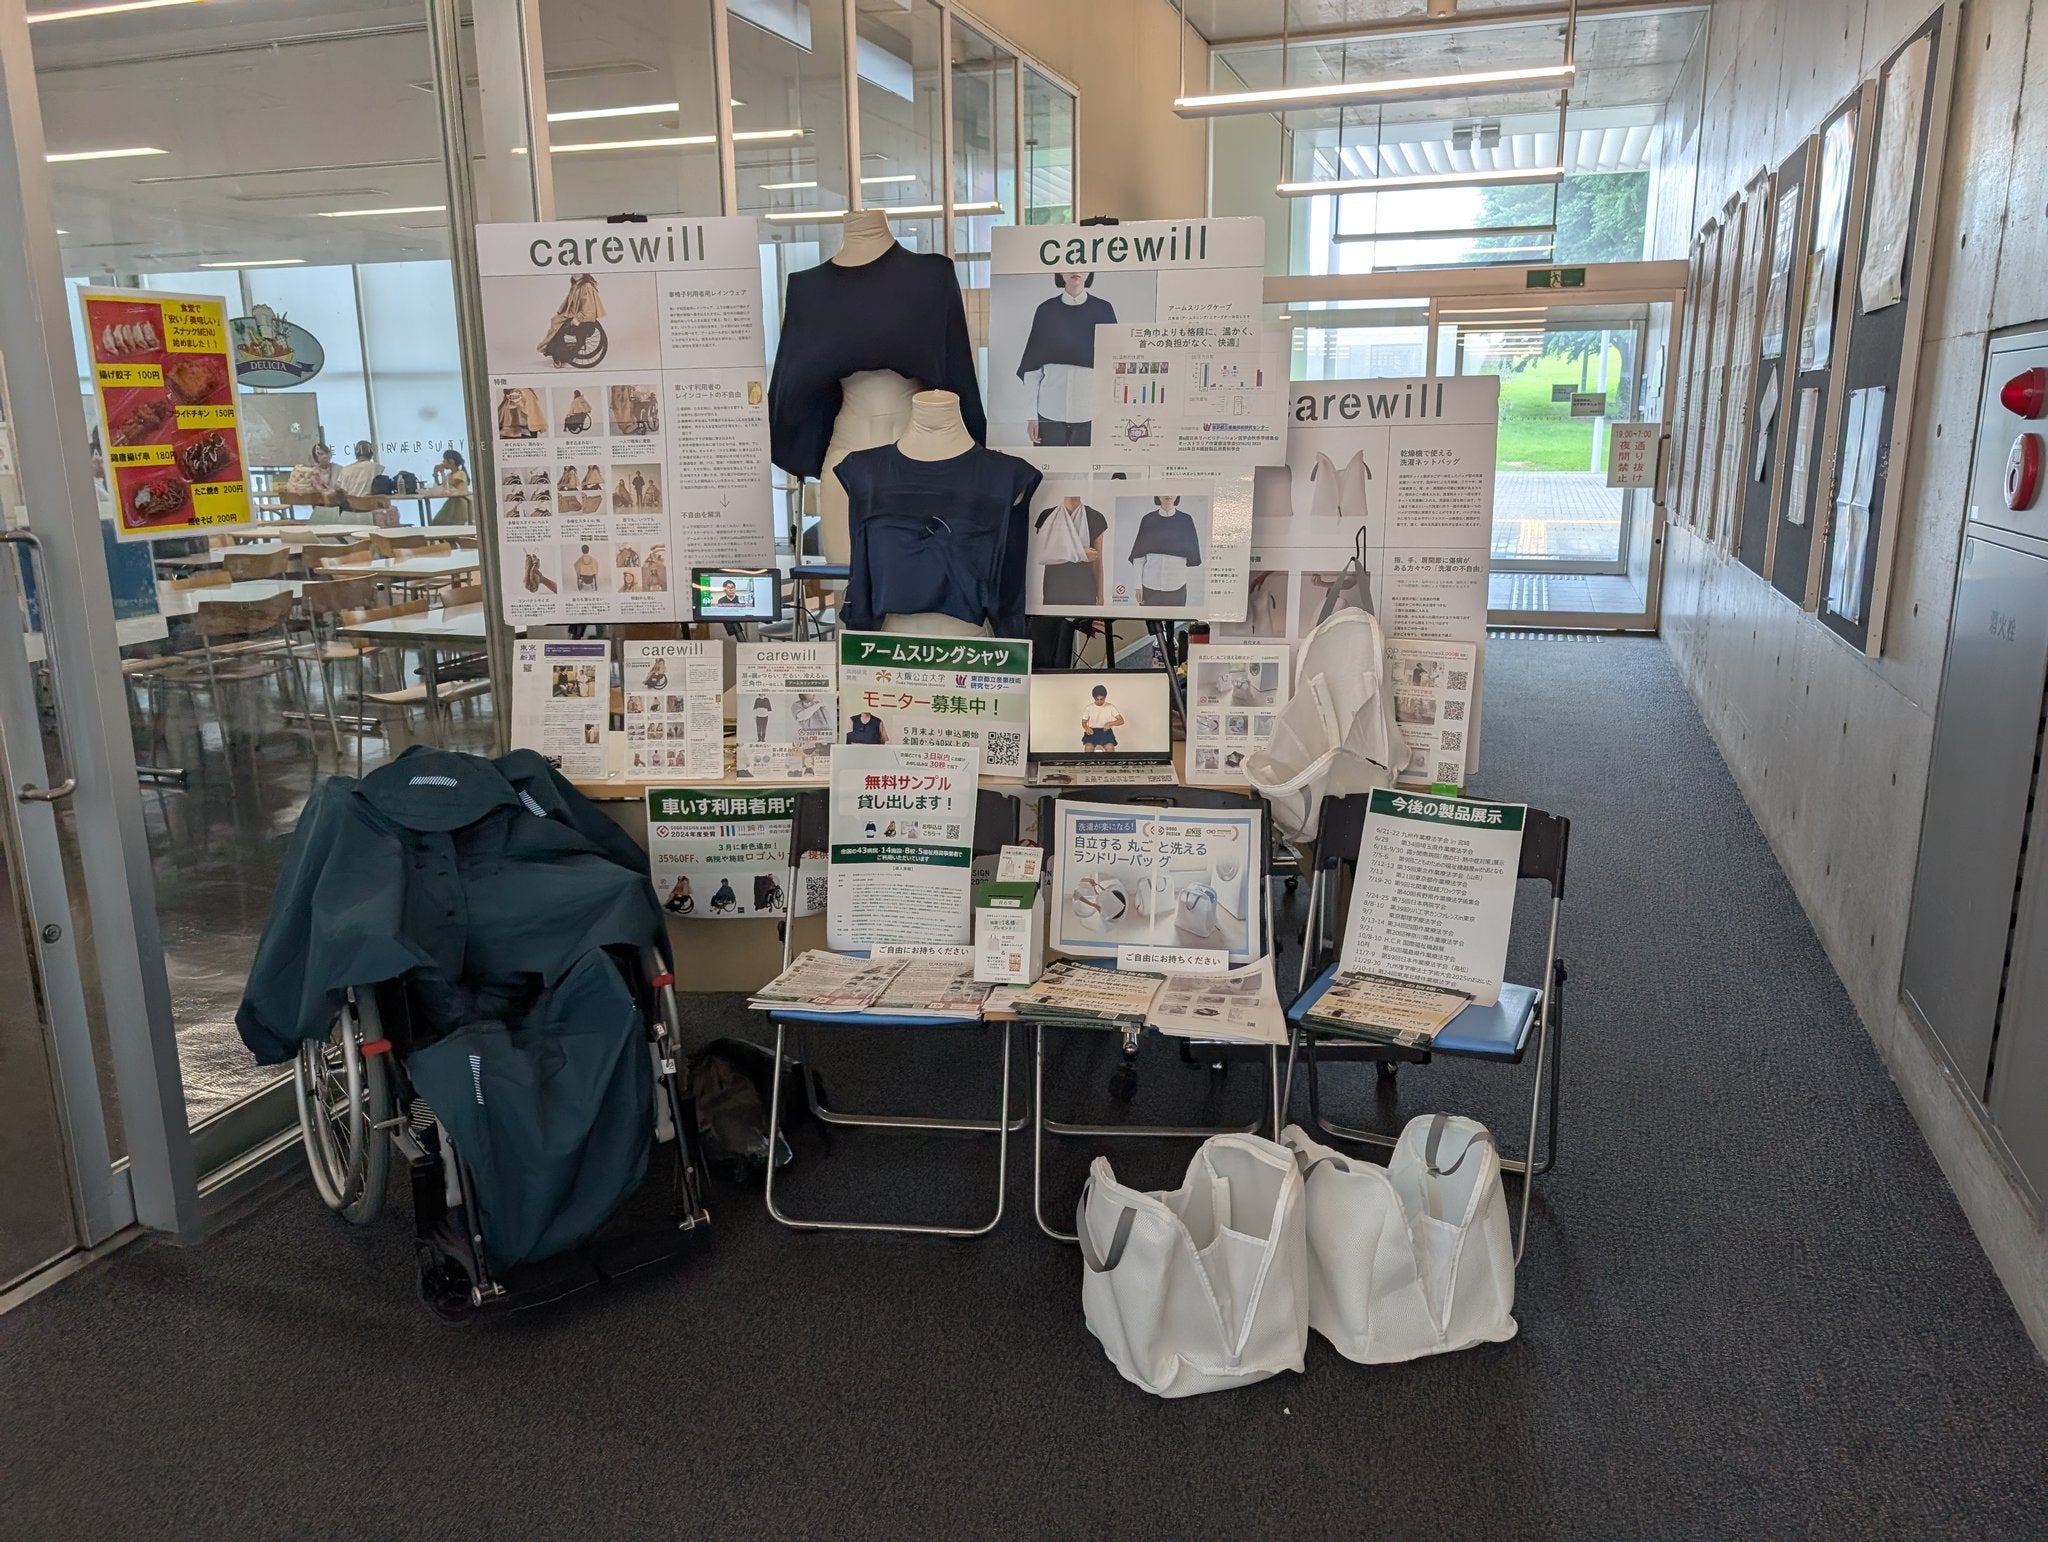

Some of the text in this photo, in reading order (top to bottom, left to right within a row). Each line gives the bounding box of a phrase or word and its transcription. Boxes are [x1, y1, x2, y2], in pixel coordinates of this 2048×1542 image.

[530, 225, 704, 267] carewill
[1039, 225, 1206, 266] carewill
[181, 304, 200, 313] 食堂で
[1131, 326, 1254, 338] 『三角巾よりも格段に、温かく、
[1139, 338, 1240, 348] 首への負担がなく、快適』
[250, 360, 286, 371] DELICIA
[99, 370, 160, 380] 揚げ餃子 100円
[494, 378, 507, 386] 特徴
[1288, 383, 1442, 422] arewill
[171, 410, 234, 418] フライドチキン 150円
[1400, 449, 1452, 458] 乾燥機で使える
[1400, 458, 1460, 466] 洗濯ネットバッグ
[194, 484, 243, 496] たこ焼き 200円
[188, 514, 237, 526] 焼きそば 200円
[1394, 556, 1470, 564] 指、手、肩関節に傷病が
[642, 642, 703, 656] carewill
[860, 642, 1008, 666] アームスリングシャツ
[757, 649, 816, 661] carewill
[896, 672, 946, 682] 大阪公立大学
[971, 676, 1021, 684] 東京都立産業技術
[970, 682, 1009, 690] 研究センター
[864, 691, 999, 716] モニター募集中！
[904, 727, 979, 739] 5月末より申込開始
[865, 775, 952, 792] 無料サンプル
[858, 794, 952, 810] 貸し出します！
[1392, 796, 1502, 824] 今後の製品展示
[1376, 828, 1400, 837] 6/21-22
[719, 842, 777, 850] 3月に新色追加！
[1075, 836, 1122, 850] 自立する
[1373, 844, 1404, 853] 6/15-9/30
[1074, 851, 1171, 868] ランドリーバッグ
[1371, 860, 1394, 868] 7/12-13
[1368, 876, 1392, 885] 7/19-20
[1364, 900, 1384, 908] 8/8-10
[1365, 892, 1446, 910] 7/24-25 第75回日本病院学会
[1361, 916, 1385, 925] 9/13-14
[1359, 932, 1382, 941] 10/8-10
[879, 946, 968, 955] ご自由にお持ちください
[1356, 948, 1375, 956] 11/7-9
[1125, 953, 1221, 966] ご自由にお持ちください
[1354, 956, 1381, 966] 11/29-30
[1352, 964, 1375, 973] 1/10-11
